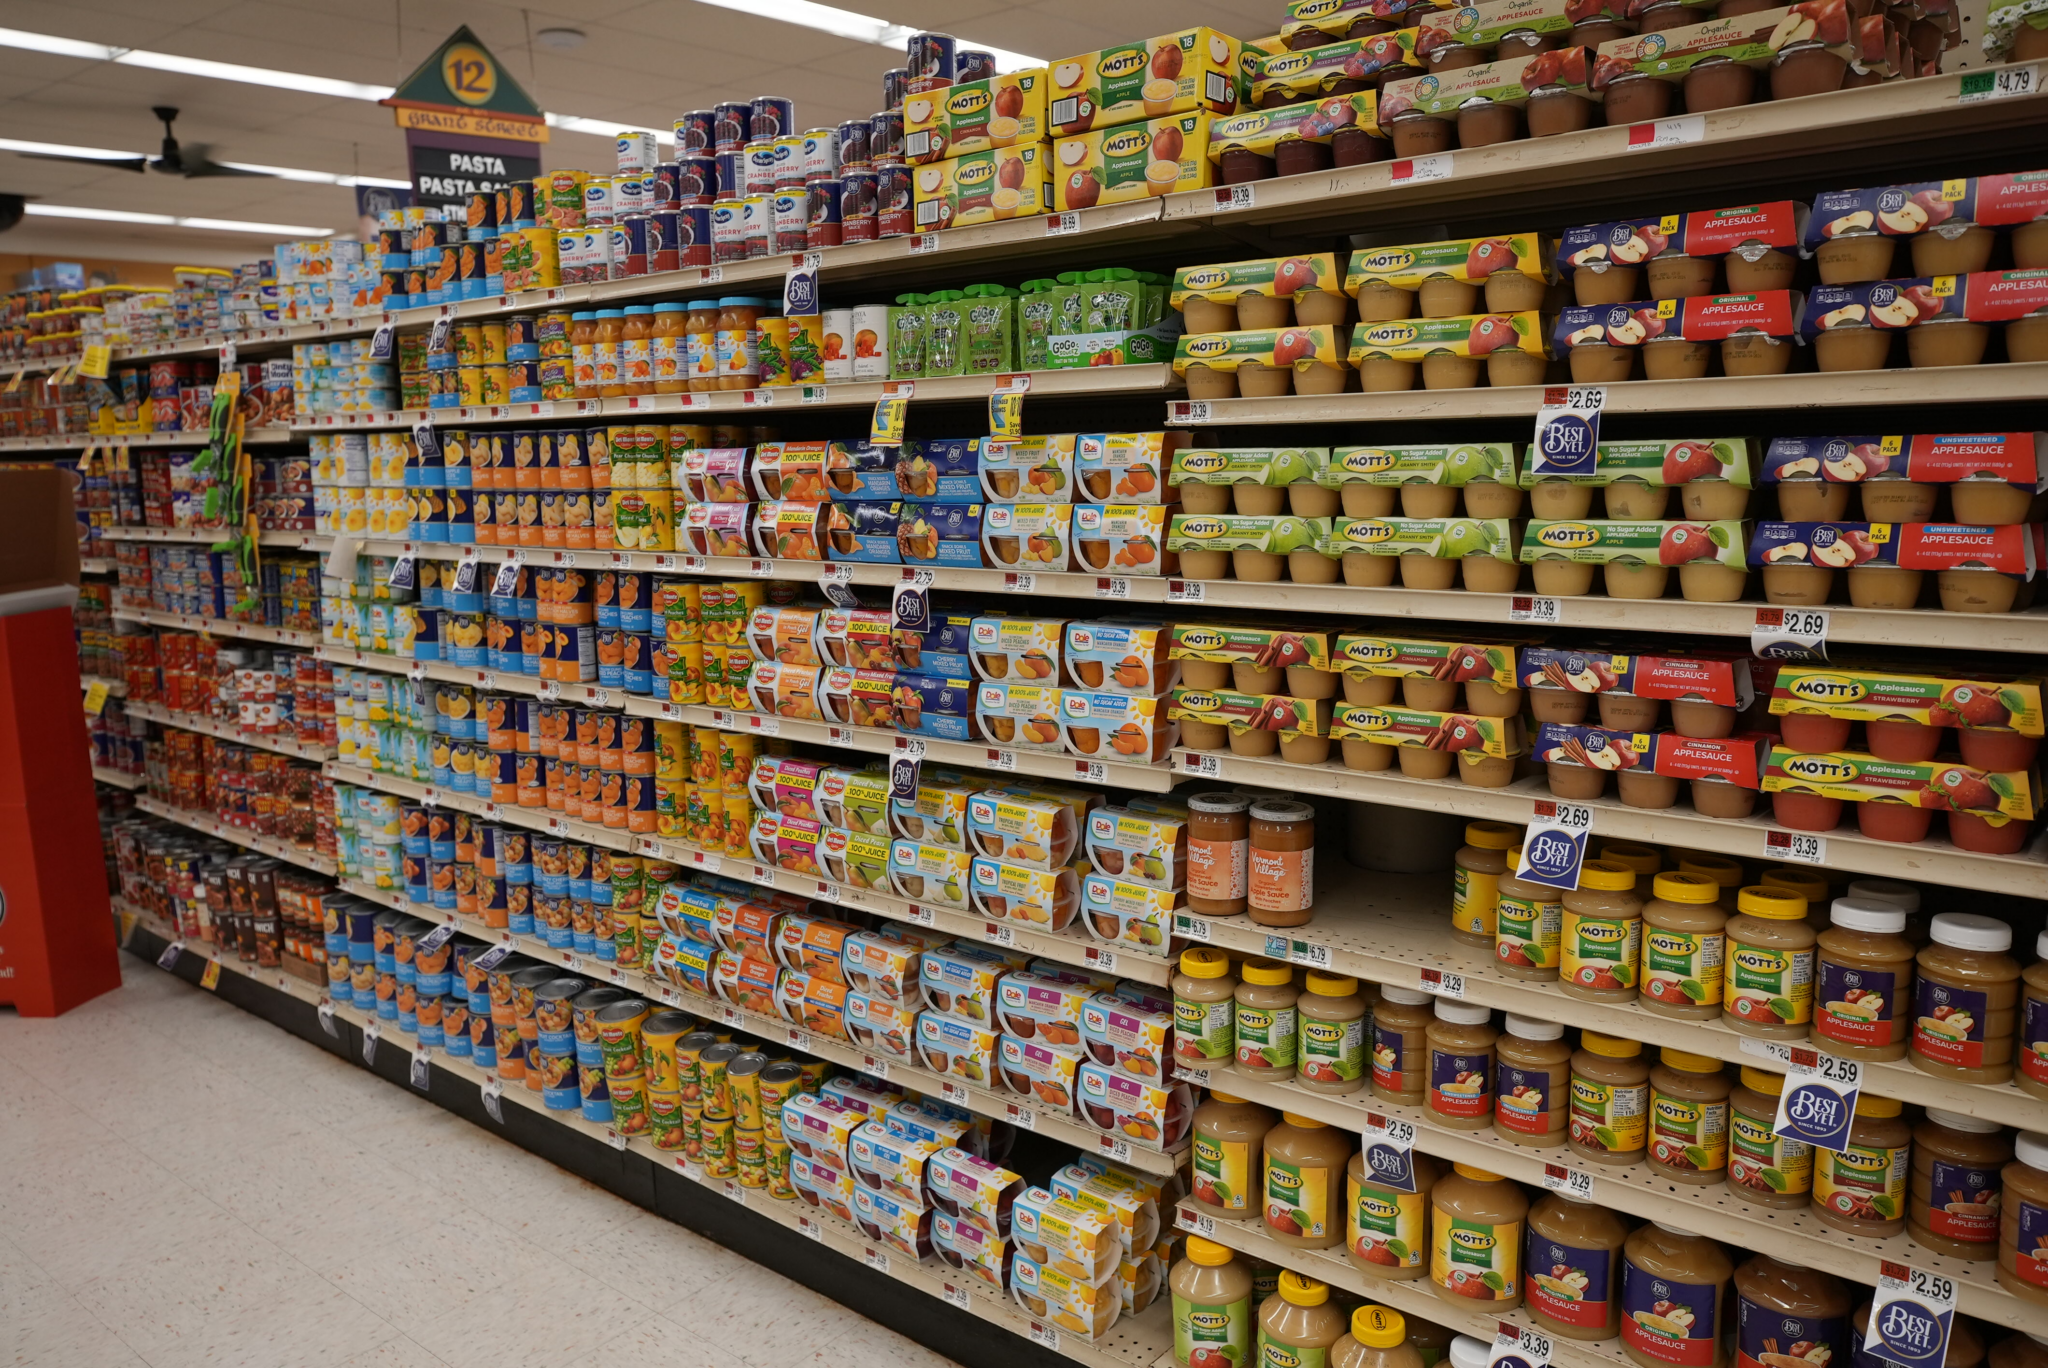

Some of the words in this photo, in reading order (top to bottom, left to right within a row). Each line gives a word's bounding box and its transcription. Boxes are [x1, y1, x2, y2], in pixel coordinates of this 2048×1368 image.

[1496, 8, 1544, 22] APPLESAUCE
[1701, 24, 1729, 36] Organic
[1183, 36, 1193, 47] 18
[1686, 31, 1742, 47] APPLESAUCE
[1317, 45, 1351, 57] Applesauce
[1698, 42, 1729, 51] CINNAMON
[1102, 53, 1146, 73] MOTT'S
[1267, 55, 1309, 73] MOTT'S
[449, 59, 489, 93] 12
[1468, 68, 1492, 78] Organic
[1022, 78, 1033, 88] 18
[1108, 77, 1139, 89] Applesauce
[1456, 77, 1500, 90] APPLESAUCE
[1998, 70, 2030, 91] $4.79
[950, 94, 988, 112] MOTT'S
[1274, 106, 1307, 119] Applesauce
[955, 115, 985, 126] Applesauce
[1183, 119, 1193, 129] 18
[1225, 116, 1265, 133] MOTT'S
[1106, 134, 1149, 154] MOTT'S
[449, 154, 506, 175] PASTA
[1111, 157, 1142, 169] Applesauce
[959, 165, 994, 180] MOTT'S
[419, 176, 475, 196] PASTA
[963, 185, 989, 196] Applesauce
[1232, 188, 1249, 205] $3.39
[1945, 190, 1962, 198] PACK
[1722, 208, 1752, 216] ORIGINAL
[1705, 215, 1767, 229] APPLESAUCE
[1662, 225, 1675, 233] PACK
[1421, 246, 1458, 255] Applesauce
[804, 255, 820, 269] $1.79
[1365, 254, 1412, 268] MOTT'S
[1234, 266, 1266, 275] Applesauce
[1187, 272, 1227, 285] MOTT'S
[789, 280, 810, 301] BEST
[1702, 303, 1764, 314] APPLESAUCE
[1368, 327, 1413, 340] MOTT'S
[1190, 339, 1228, 352] MOTT'S
[1569, 391, 1602, 408] $2.69
[1191, 404, 1206, 418] $3.39
[1545, 422, 1585, 453] BEST
[1563, 442, 1585, 453] YET
[1931, 446, 2004, 454] APPLESAUCE
[1185, 456, 1224, 468] MOTT'S
[1346, 454, 1392, 468] MOTT'S
[1082, 513, 1097, 521] Dole
[1542, 529, 1594, 541] MOTT'S
[1921, 536, 1994, 544] APPLESAUCE
[915, 572, 932, 585] $2.79
[1111, 579, 1125, 593] $3.39
[1185, 582, 1200, 597] $3.39
[898, 596, 919, 617] BEST
[1533, 600, 1554, 615] $3.39
[1760, 613, 1779, 622] $1.79
[1784, 613, 1823, 634] $2.69
[867, 624, 887, 632] JUICE
[1075, 633, 1090, 642] Dole
[1184, 633, 1222, 646] MOTT'S
[1349, 645, 1393, 658] MOTT'S
[1403, 647, 1437, 655] Applesauce
[1652, 669, 1709, 680] APPLESAUCE
[1796, 682, 1859, 697] MOTT'S
[1874, 684, 1925, 693] Applesauce
[1688, 741, 1721, 750] CINNAMON
[1673, 749, 1732, 762] APPLESAUCE
[1200, 756, 1216, 772] $3.39
[1789, 763, 1851, 777] MOTT'S
[1865, 777, 1910, 785] STRAWBERRY
[864, 791, 885, 801] JUICE
[1557, 806, 1589, 826] $2.69
[1531, 837, 1571, 864] BEST
[1792, 837, 1818, 856] $3.39
[1253, 854, 1284, 867] Vermont
[1550, 855, 1569, 867] YET
[1254, 866, 1286, 880] Village
[1580, 925, 1622, 938] MOTT'S
[1309, 945, 1325, 960] $6.79
[1585, 943, 1616, 952] Applesauce
[1443, 974, 1461, 990] $3.29
[1837, 1012, 1863, 1022] ORIGINAL
[1827, 1016, 1875, 1032] APPLESAUCE
[1819, 1057, 1858, 1083] $2.59
[1441, 1096, 1479, 1105] APPLESAUCE
[1791, 1090, 1839, 1119] BEST
[1813, 1112, 1836, 1126] YET
[1386, 1119, 1413, 1140] $2.59
[1570, 1172, 1590, 1190] $3.29
[1947, 1218, 1996, 1228] APPLESAUCE
[1453, 1232, 1492, 1245] MOTT'S
[1457, 1248, 1485, 1258] Applesauce
[1911, 1270, 1952, 1300] $2.59
[1535, 1289, 1580, 1311] APPLESAUCE
[1193, 1315, 1226, 1323] MOTT'S
[1882, 1305, 1933, 1338] BEST
[1520, 1329, 1549, 1356] $3.39
[1635, 1328, 1686, 1350] APPLESAUCE
[1906, 1329, 1930, 1348] YET
